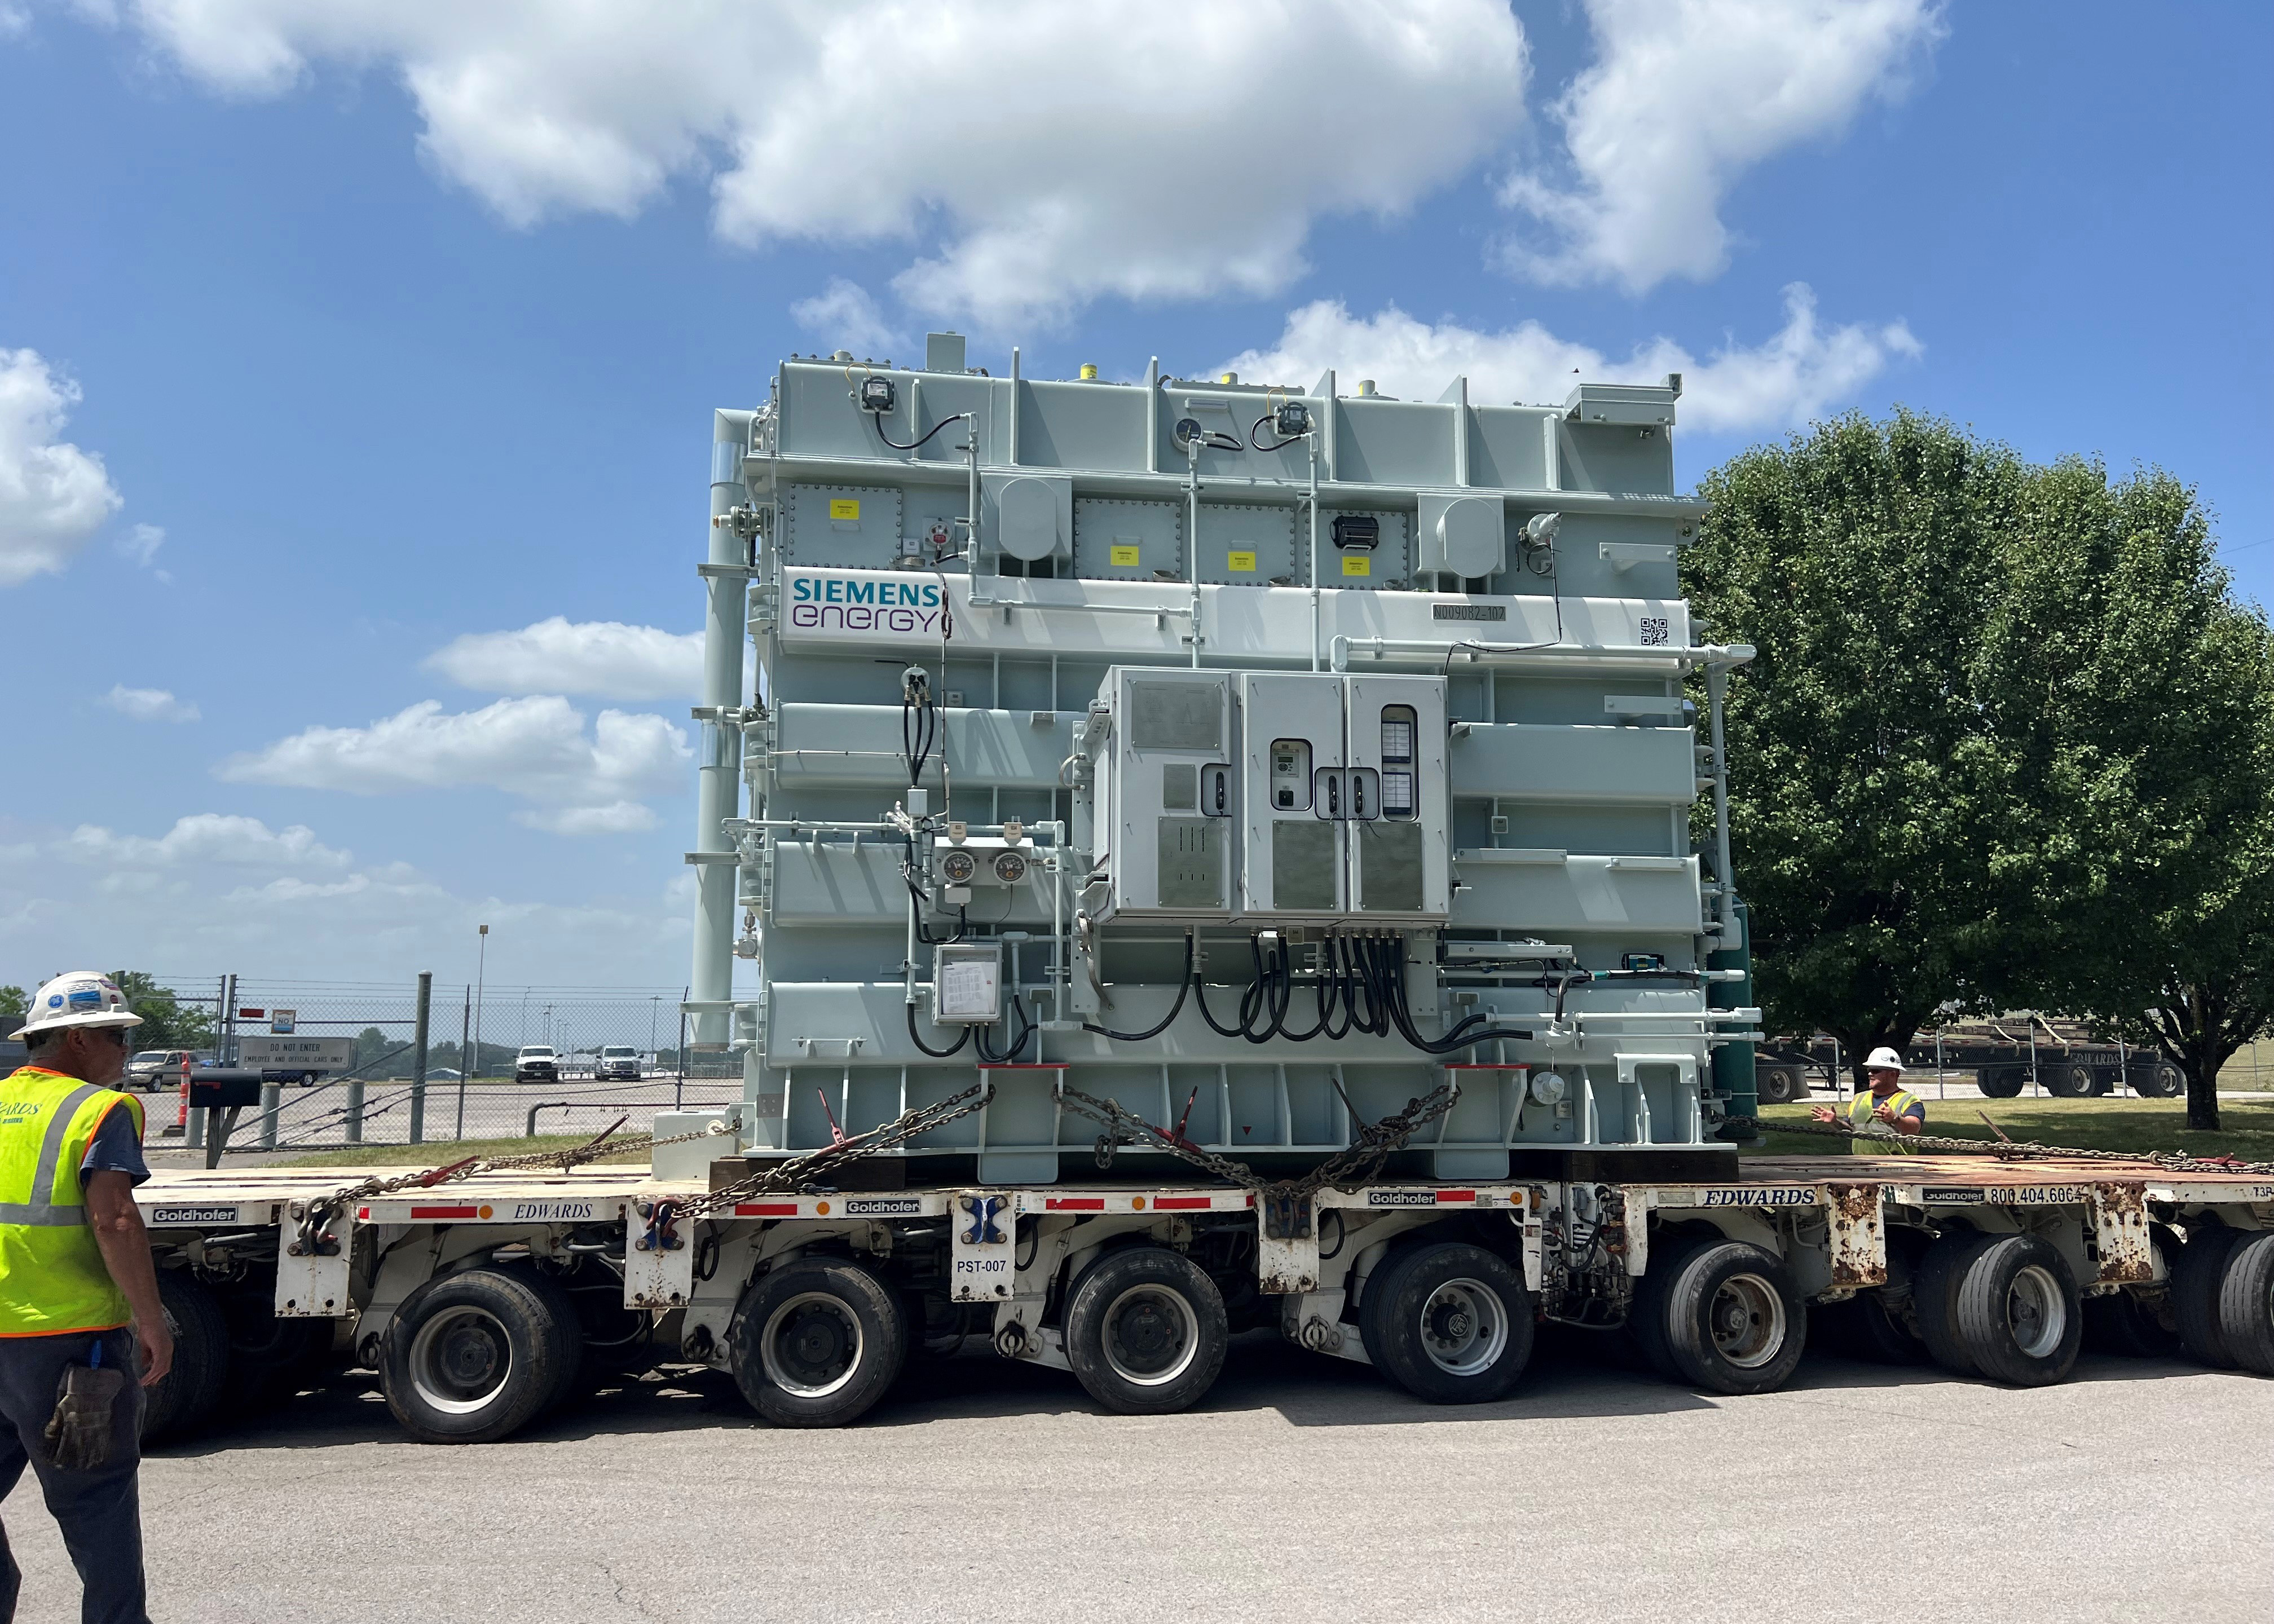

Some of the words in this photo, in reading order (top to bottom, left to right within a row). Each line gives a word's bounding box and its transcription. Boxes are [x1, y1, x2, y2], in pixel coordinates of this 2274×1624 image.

[794, 578, 940, 607] SIEMENS
[1434, 605, 1504, 620] N009082-102
[270, 1043, 279, 1052] DO
[283, 1043, 296, 1052] NOT
[300, 1043, 320, 1052] ENTER
[1370, 1193, 1434, 1203] Goldhofer
[1704, 1189, 1815, 1205] EDWARDS
[514, 1203, 593, 1219] EDWARDS
[848, 1201, 919, 1212] Goldhofer
[155, 1209, 235, 1221] Goldhofer
[958, 1260, 1006, 1272] PST-007
